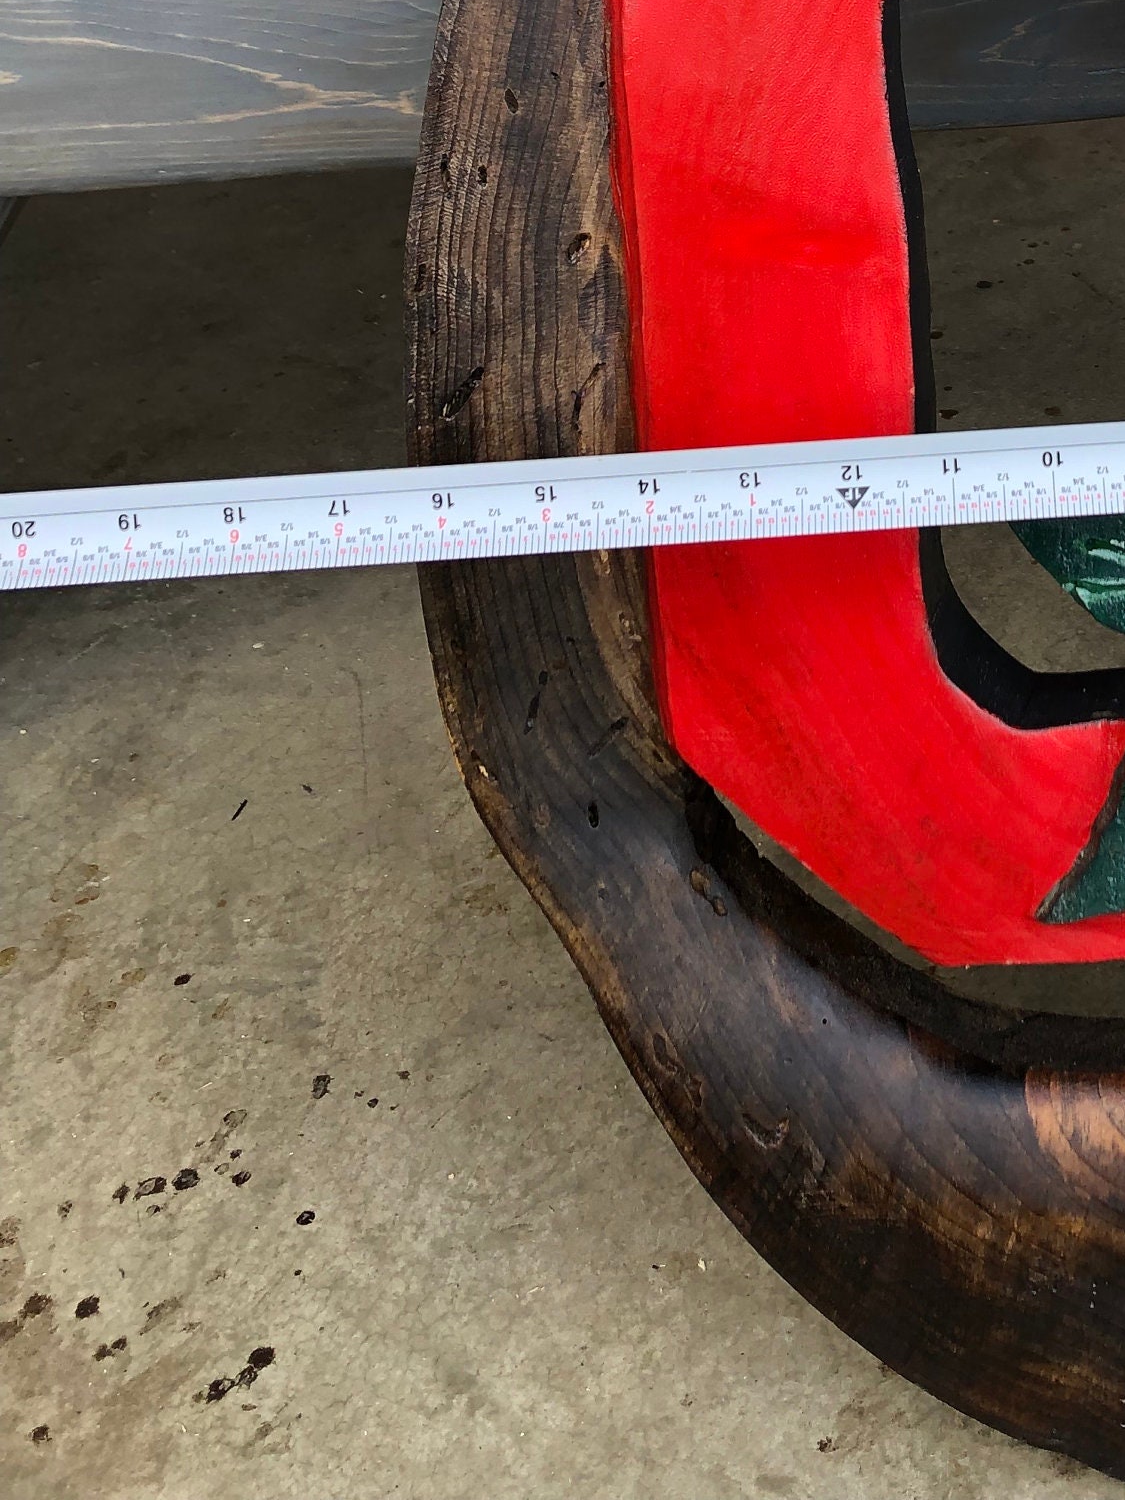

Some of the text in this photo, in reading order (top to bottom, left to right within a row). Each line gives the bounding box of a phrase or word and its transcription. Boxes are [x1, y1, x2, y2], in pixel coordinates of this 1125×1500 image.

[943, 458, 960, 473] 11
[1043, 451, 1063, 466] 10
[740, 472, 760, 488] 13
[842, 465, 862, 480] 12
[535, 486, 556, 501] 15
[638, 479, 660, 494] 14
[329, 500, 349, 515] 17
[432, 493, 453, 508] 16
[119, 514, 140, 530] 19
[224, 507, 245, 523] 18
[12, 521, 35, 537] 20
[18, 493, 756, 557] 1 2 3 4 5 6 7 8
